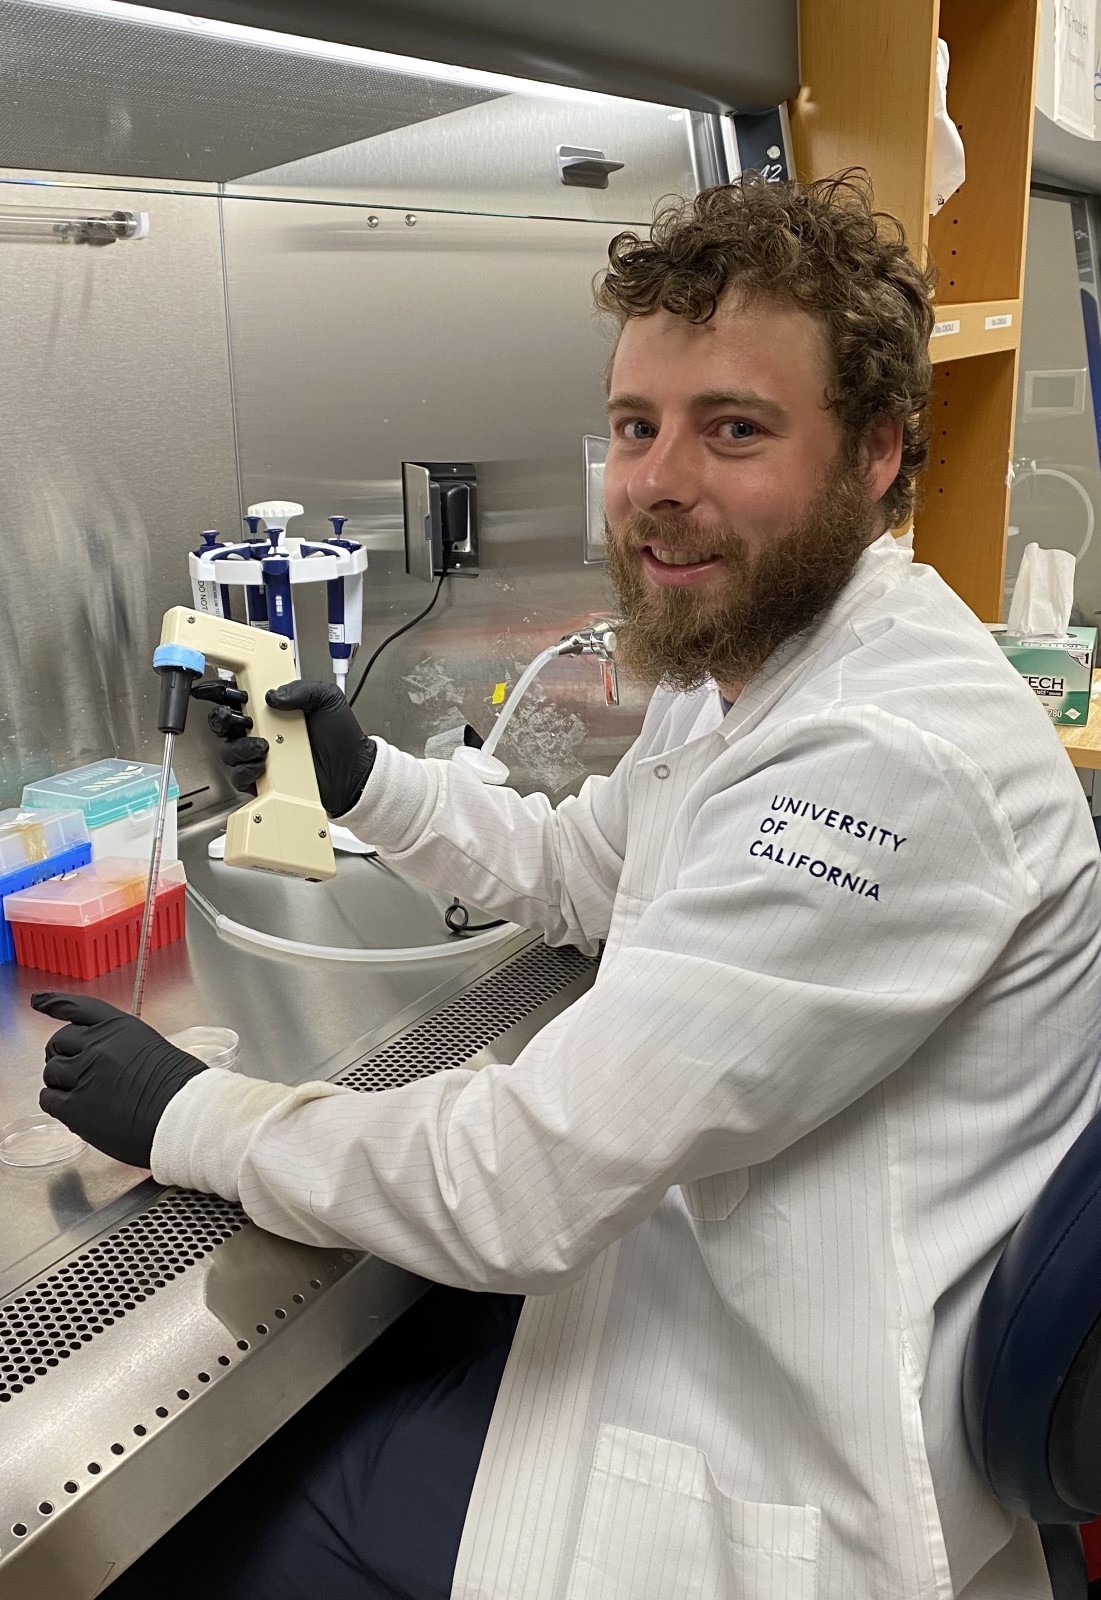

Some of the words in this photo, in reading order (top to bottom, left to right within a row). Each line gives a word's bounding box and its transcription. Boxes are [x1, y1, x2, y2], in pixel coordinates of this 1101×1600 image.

[198, 581, 206, 593] DO
[200, 594, 209, 611] NOT
[1084, 653, 1089, 664] 1
[760, 817, 788, 835] OF
[771, 795, 907, 852] UNIVERSITY
[749, 840, 881, 902] CALIFORNIA
